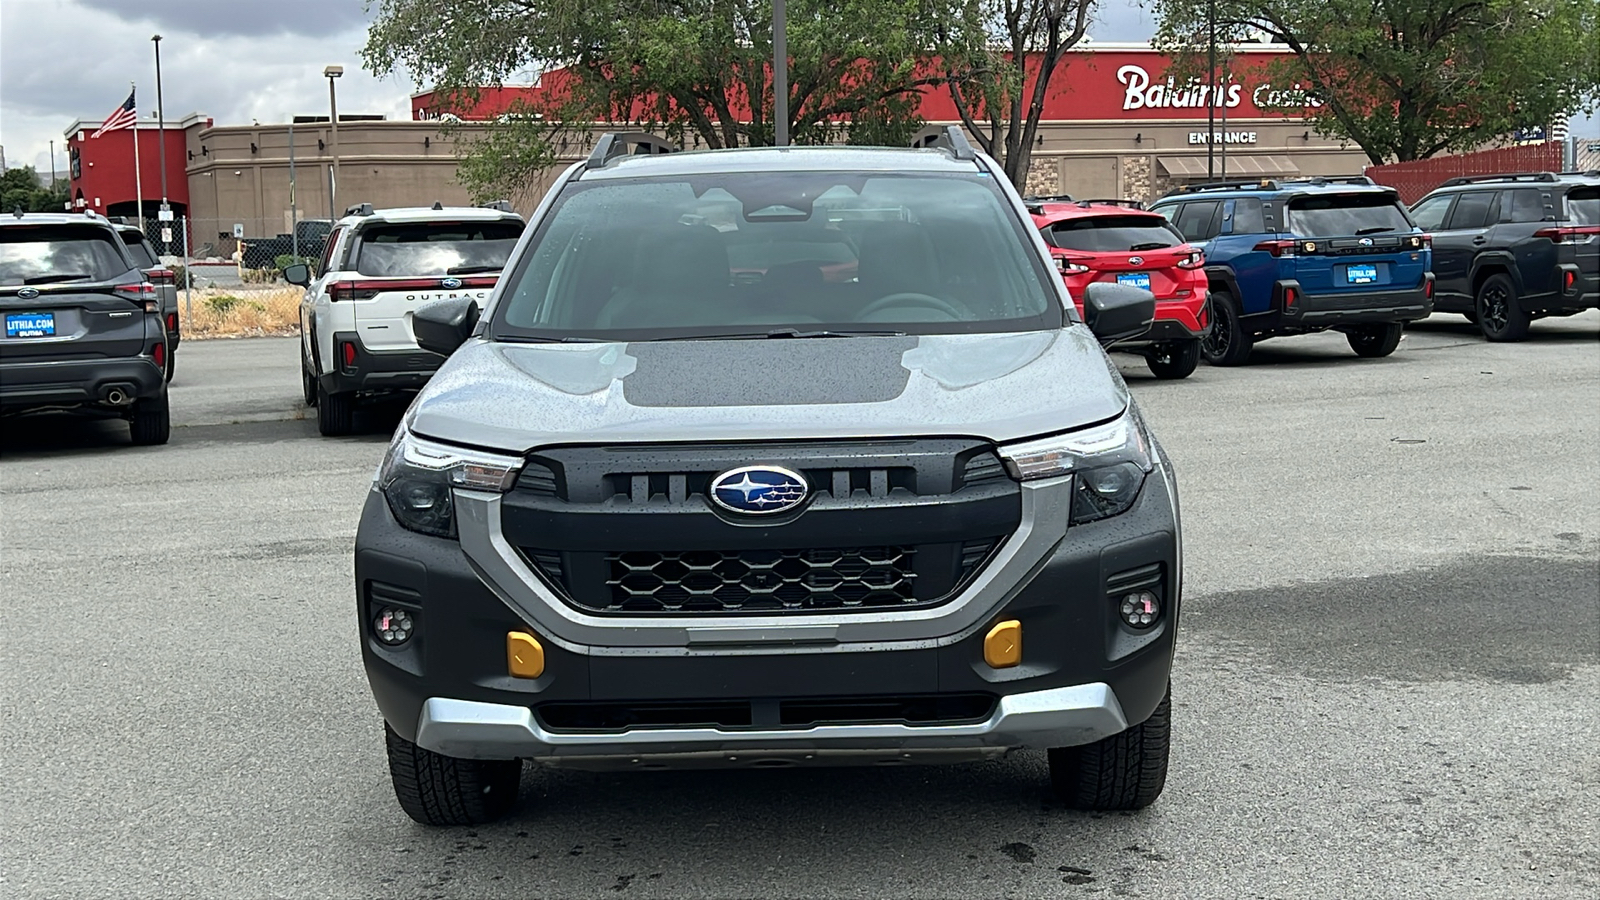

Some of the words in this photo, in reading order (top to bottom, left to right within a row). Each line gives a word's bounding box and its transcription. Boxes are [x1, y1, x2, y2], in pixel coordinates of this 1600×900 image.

[1189, 132, 1256, 145] ENTRANCE
[406, 292, 491, 301] OUTBAC
[6, 318, 54, 330] LITHIA.COM
